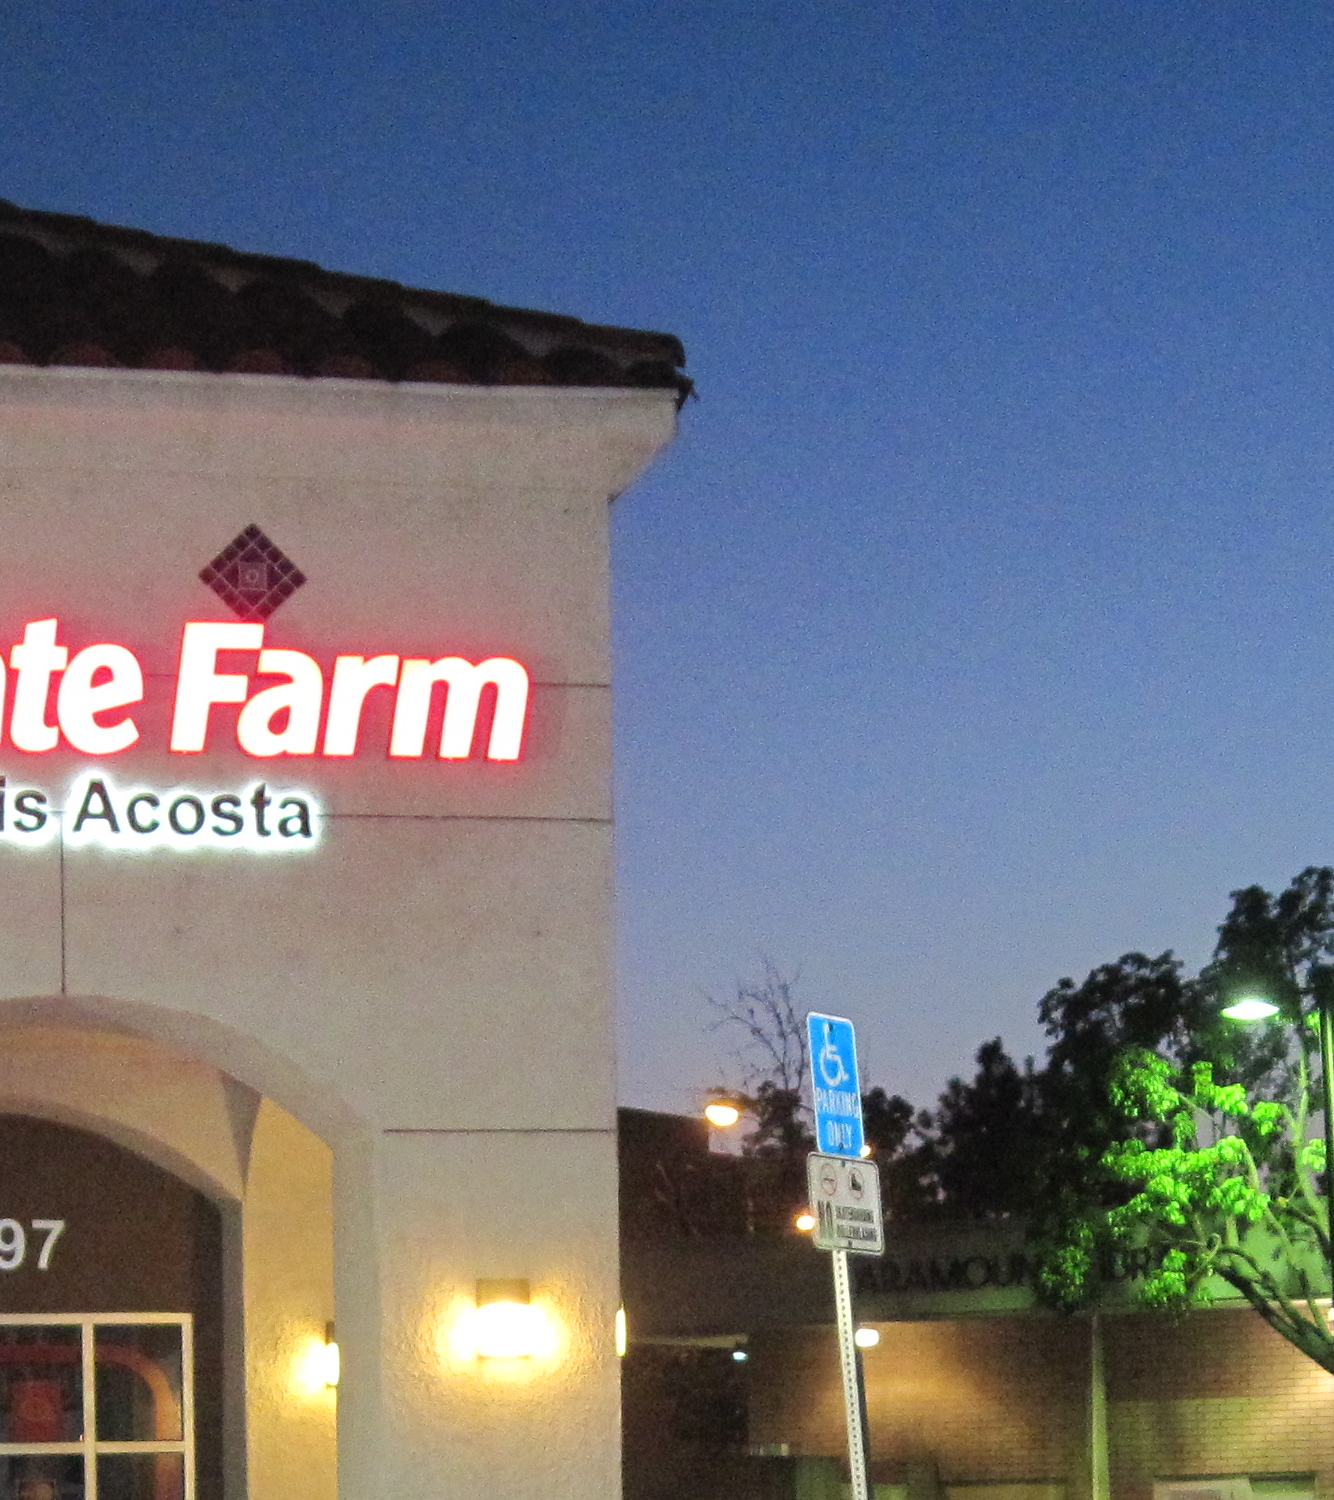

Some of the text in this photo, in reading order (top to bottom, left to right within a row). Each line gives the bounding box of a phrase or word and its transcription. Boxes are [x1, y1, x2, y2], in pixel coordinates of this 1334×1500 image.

[169, 620, 530, 761] Farm
[72, 779, 313, 839] Acosta
[816, 1087, 860, 1118] PARKING
[827, 1120, 853, 1148] ONLY
